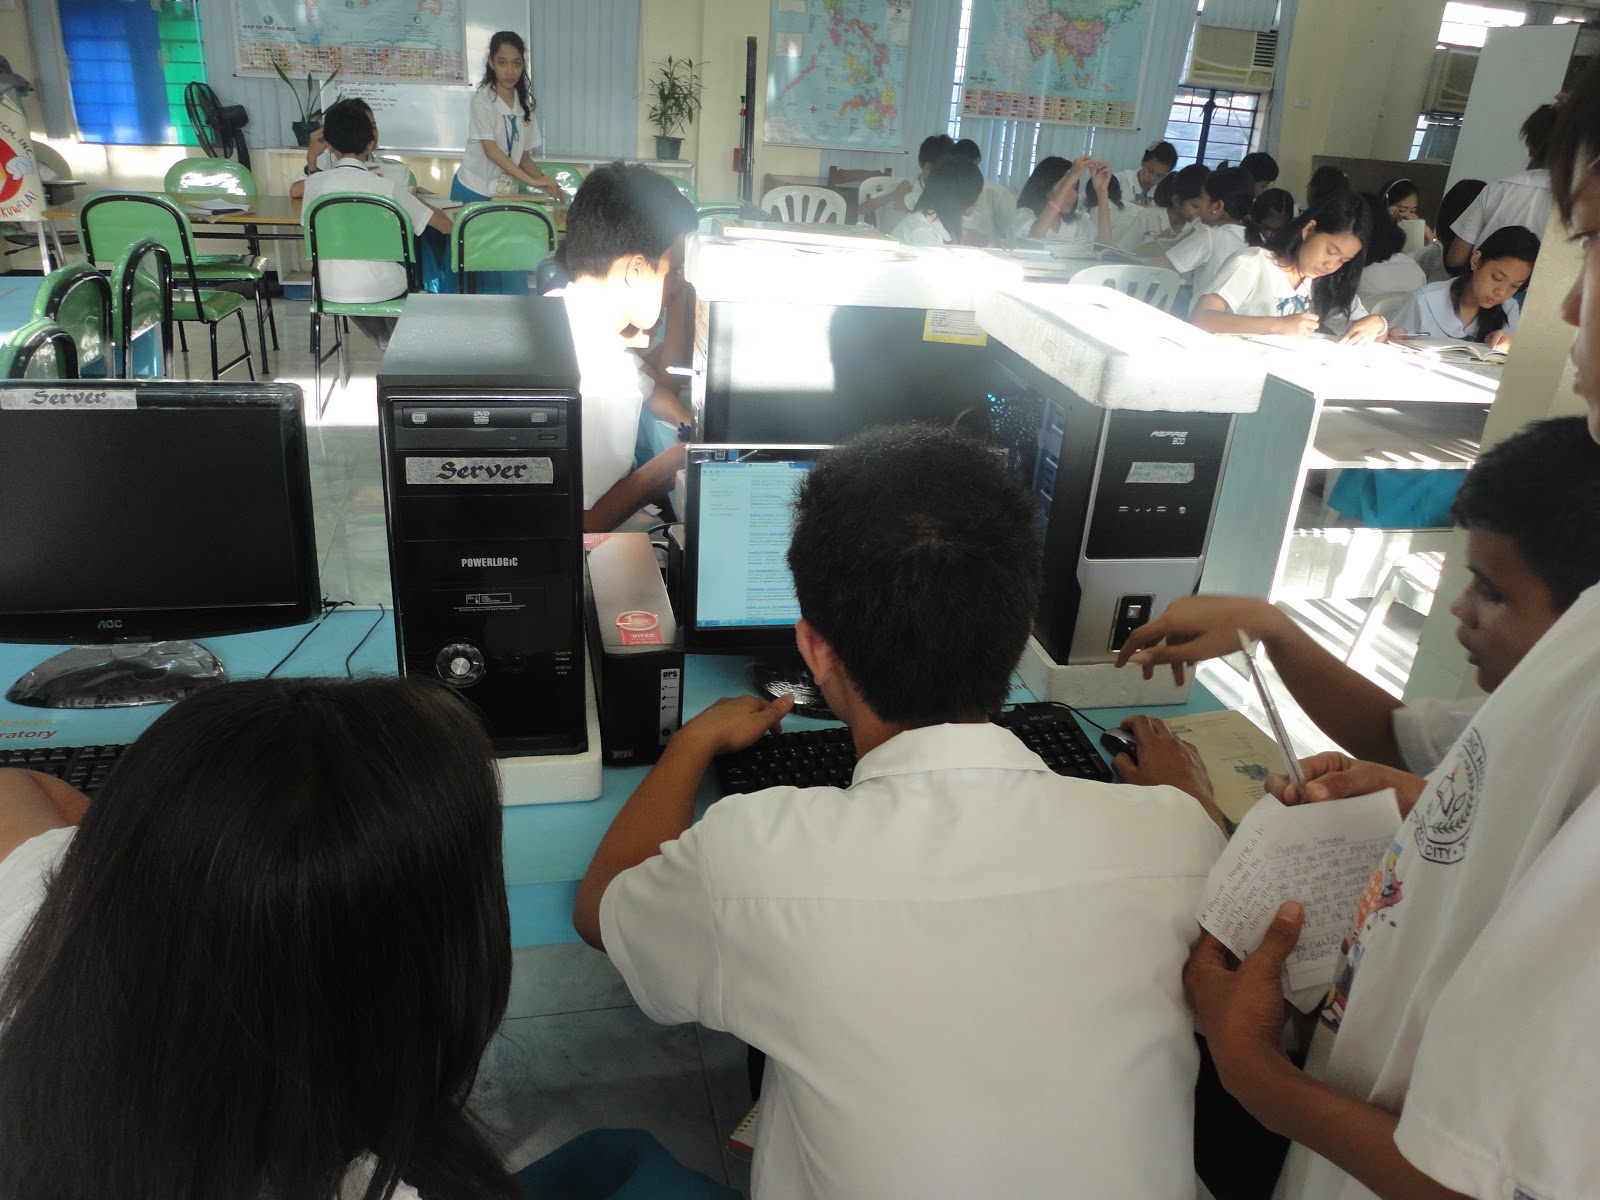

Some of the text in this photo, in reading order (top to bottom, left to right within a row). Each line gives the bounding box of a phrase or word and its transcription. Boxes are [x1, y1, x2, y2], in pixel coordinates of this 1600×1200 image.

[0, 121, 34, 160] CH, INC.
[0, 189, 39, 219] KUWELA!
[28, 390, 107, 405] Server
[435, 461, 528, 480] Server
[97, 619, 123, 629] AOC
[662, 670, 678, 678] UPS
[1424, 844, 1452, 860] CITY
